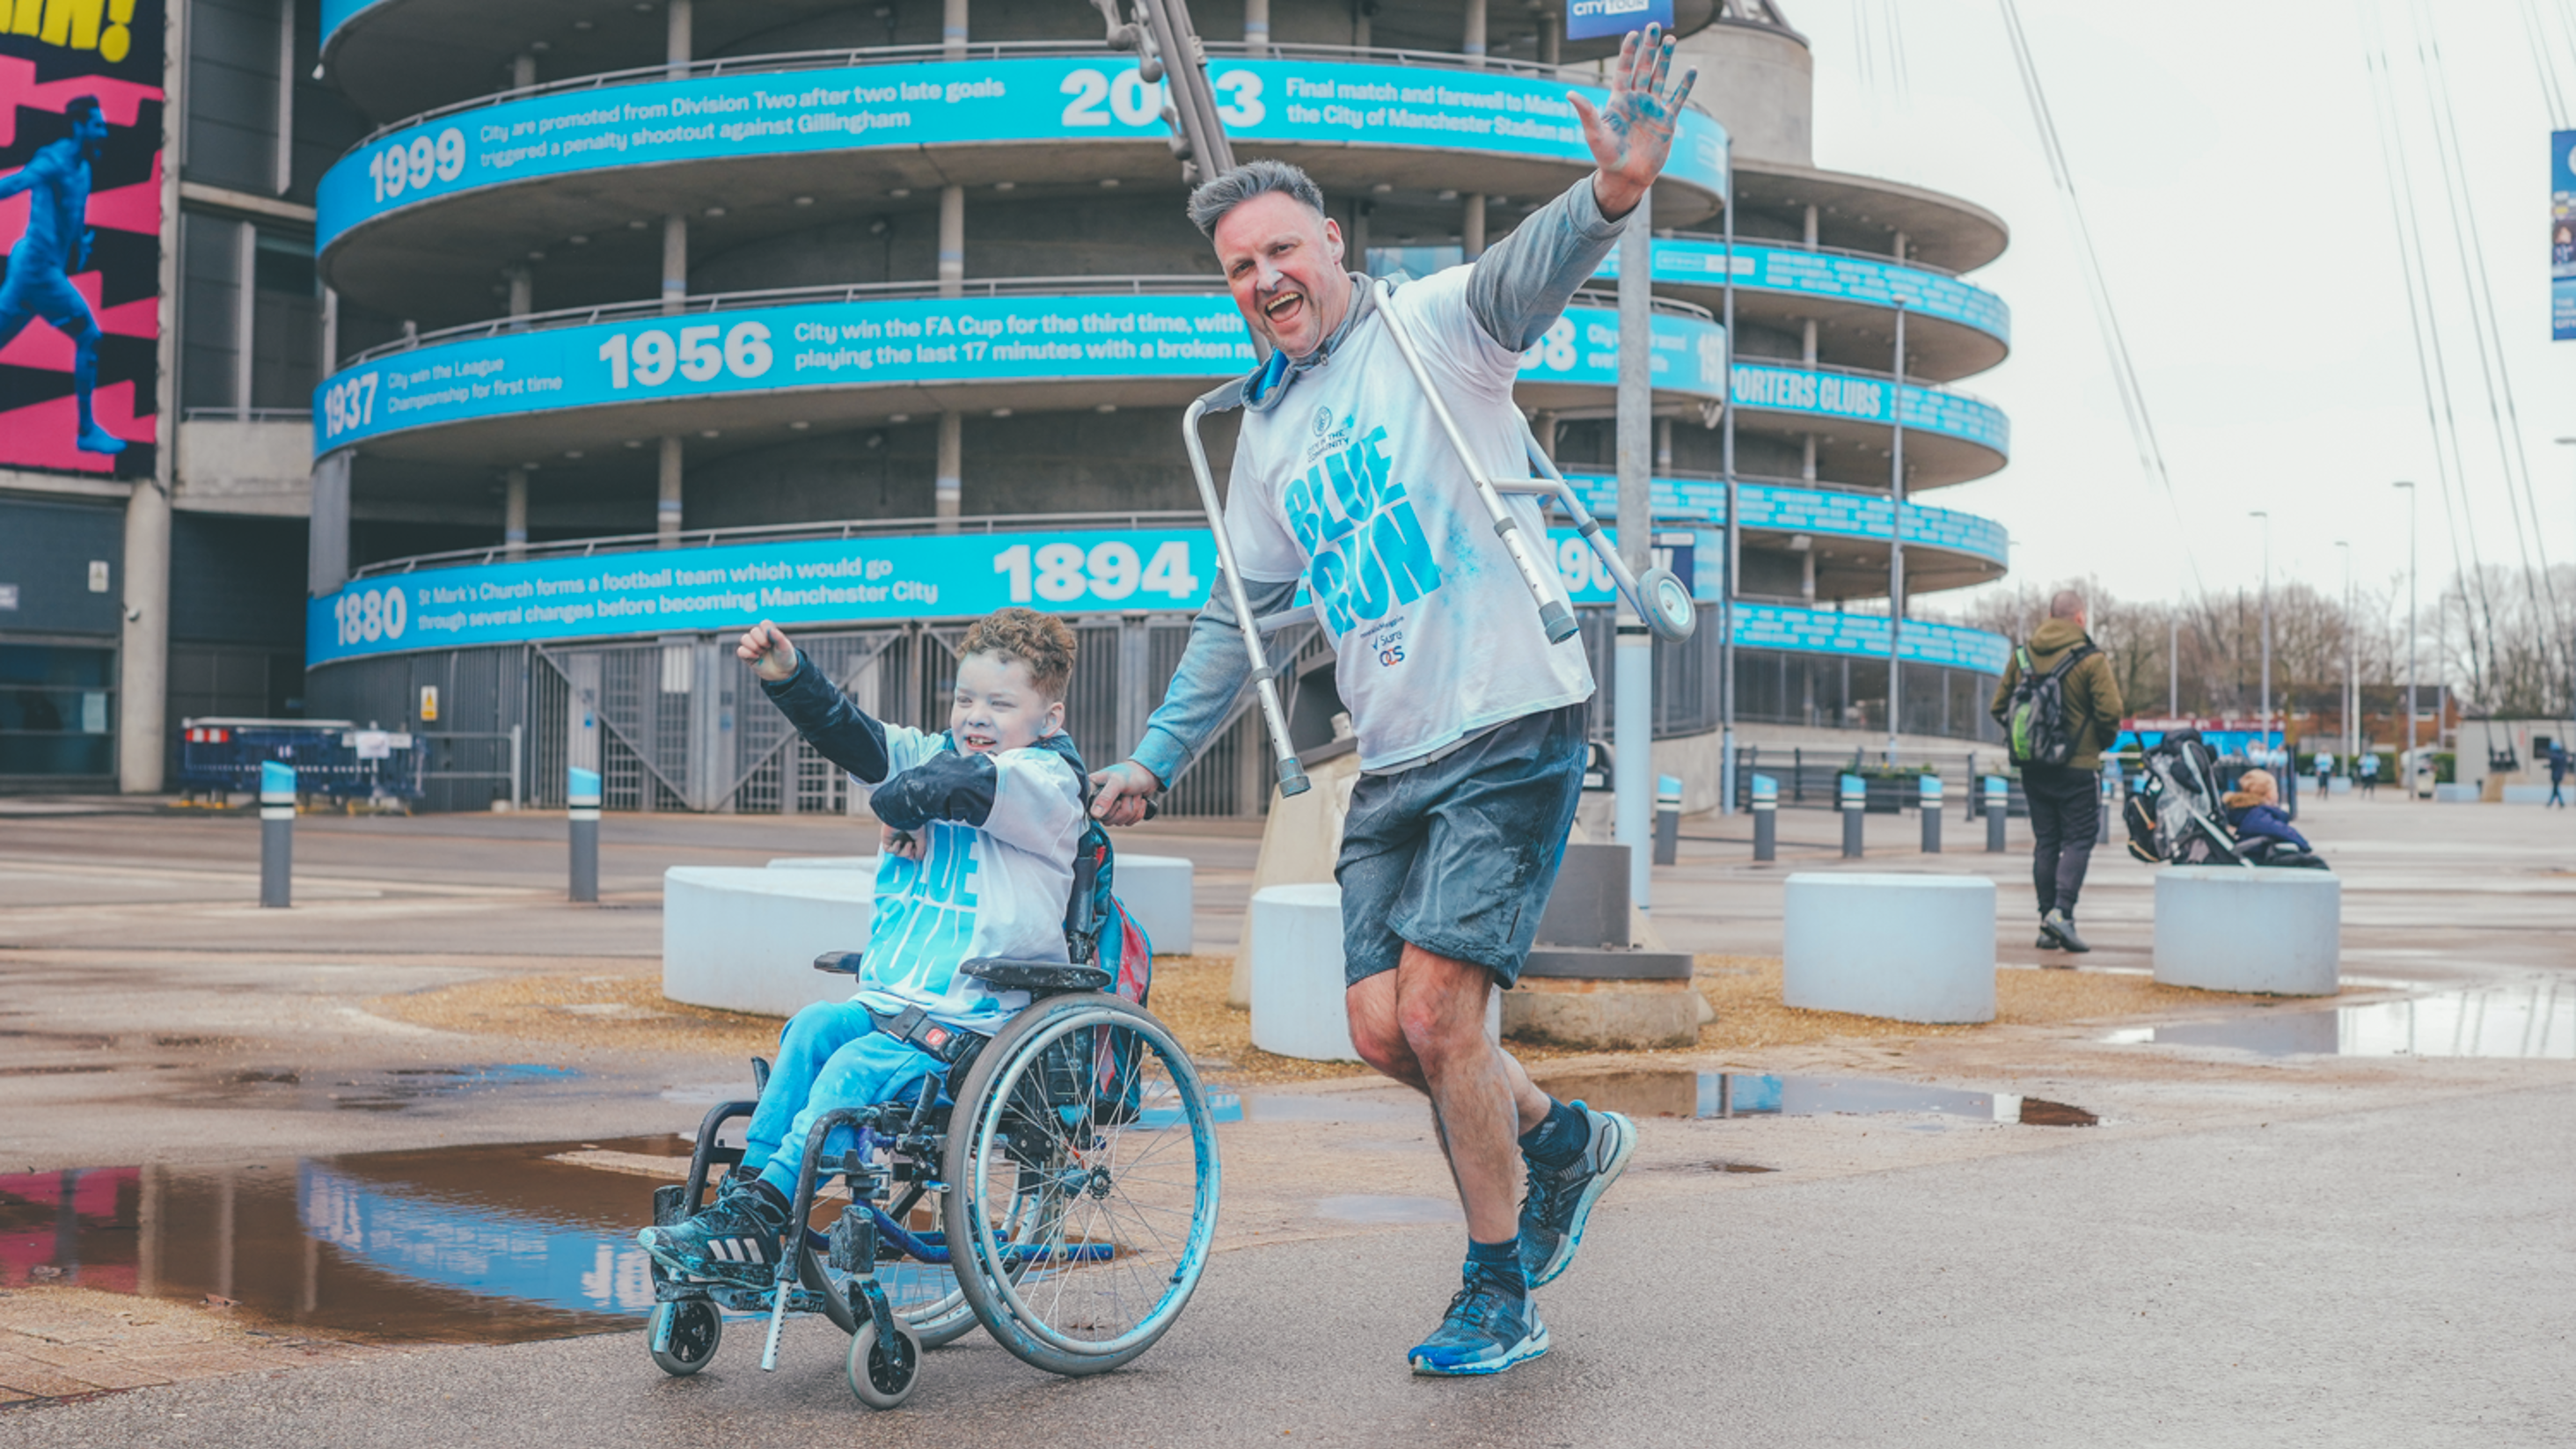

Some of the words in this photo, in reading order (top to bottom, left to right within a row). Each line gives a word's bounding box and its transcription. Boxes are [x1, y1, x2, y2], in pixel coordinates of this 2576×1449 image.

[1573, 0, 1605, 16] CITY
[480, 124, 509, 144] City
[512, 121, 536, 137] are
[539, 105, 620, 134] promoted
[624, 99, 668, 121] from
[671, 94, 749, 116] Division
[753, 91, 796, 111] Two
[799, 85, 849, 106] after
[853, 82, 897, 103] two
[900, 82, 942, 100] late
[945, 77, 1005, 103] goals
[1060, 68, 1265, 127] 203
[1286, 77, 1336, 99] Final
[1338, 80, 1398, 103] match
[1401, 84, 1434, 106] and
[1438, 86, 1503, 111] farewell
[1505, 91, 1521, 111] to
[551, 140, 560, 155] a
[563, 130, 627, 154] penalty
[632, 121, 714, 144] shootout
[719, 117, 794, 141] against
[798, 109, 911, 133] Gillingham
[1287, 104, 1319, 123] the
[1322, 104, 1364, 128] City
[1367, 106, 1385, 126] of
[1388, 109, 1493, 134] Manchester
[1496, 115, 1556, 141] Stadium
[369, 128, 465, 202] 1999
[794, 321, 838, 345] City
[842, 319, 881, 339] win
[884, 318, 920, 337] the
[926, 317, 955, 335] FA
[958, 316, 1002, 339] Cup
[1006, 314, 1041, 334] for
[1043, 314, 1079, 333] the
[1081, 312, 1136, 333] third
[1138, 313, 1193, 335] time,
[1195, 312, 1244, 333] with
[388, 370, 408, 390] City
[410, 370, 431, 384] win
[433, 362, 452, 381] the
[454, 357, 504, 377] League
[598, 321, 773, 389] 1956
[795, 348, 872, 370] playing
[876, 346, 912, 365] the
[916, 343, 959, 362] last
[962, 342, 988, 362] 17
[992, 341, 1083, 360] minutes
[1087, 340, 1137, 359] with
[1140, 342, 1153, 359] a
[1158, 340, 1231, 359] broken
[324, 371, 379, 438] 1937
[388, 385, 469, 414] Championship
[472, 381, 490, 399] for
[493, 377, 523, 396] first
[527, 375, 562, 393] time
[1819, 376, 1882, 418] CLUBS
[1284, 425, 1407, 558] BLUE
[418, 589, 431, 607] St
[434, 583, 477, 605] Mark's
[479, 581, 533, 602] Church
[536, 576, 585, 597] forms
[588, 579, 600, 594] a
[602, 567, 672, 591] football
[675, 569, 728, 587] team
[730, 561, 794, 582] which
[796, 557, 863, 581] would
[866, 559, 893, 581] go
[992, 540, 1198, 604] 1894
[1311, 500, 1442, 640] RUN
[334, 585, 407, 647] 1880
[418, 611, 467, 633] through
[469, 606, 523, 628] several
[525, 603, 595, 625] changes
[597, 597, 656, 617] before
[659, 589, 757, 614] becoming
[760, 582, 889, 608] Manchester
[891, 580, 939, 604] City
[1379, 646, 1405, 667] OCS
[860, 896, 977, 996] RUN
